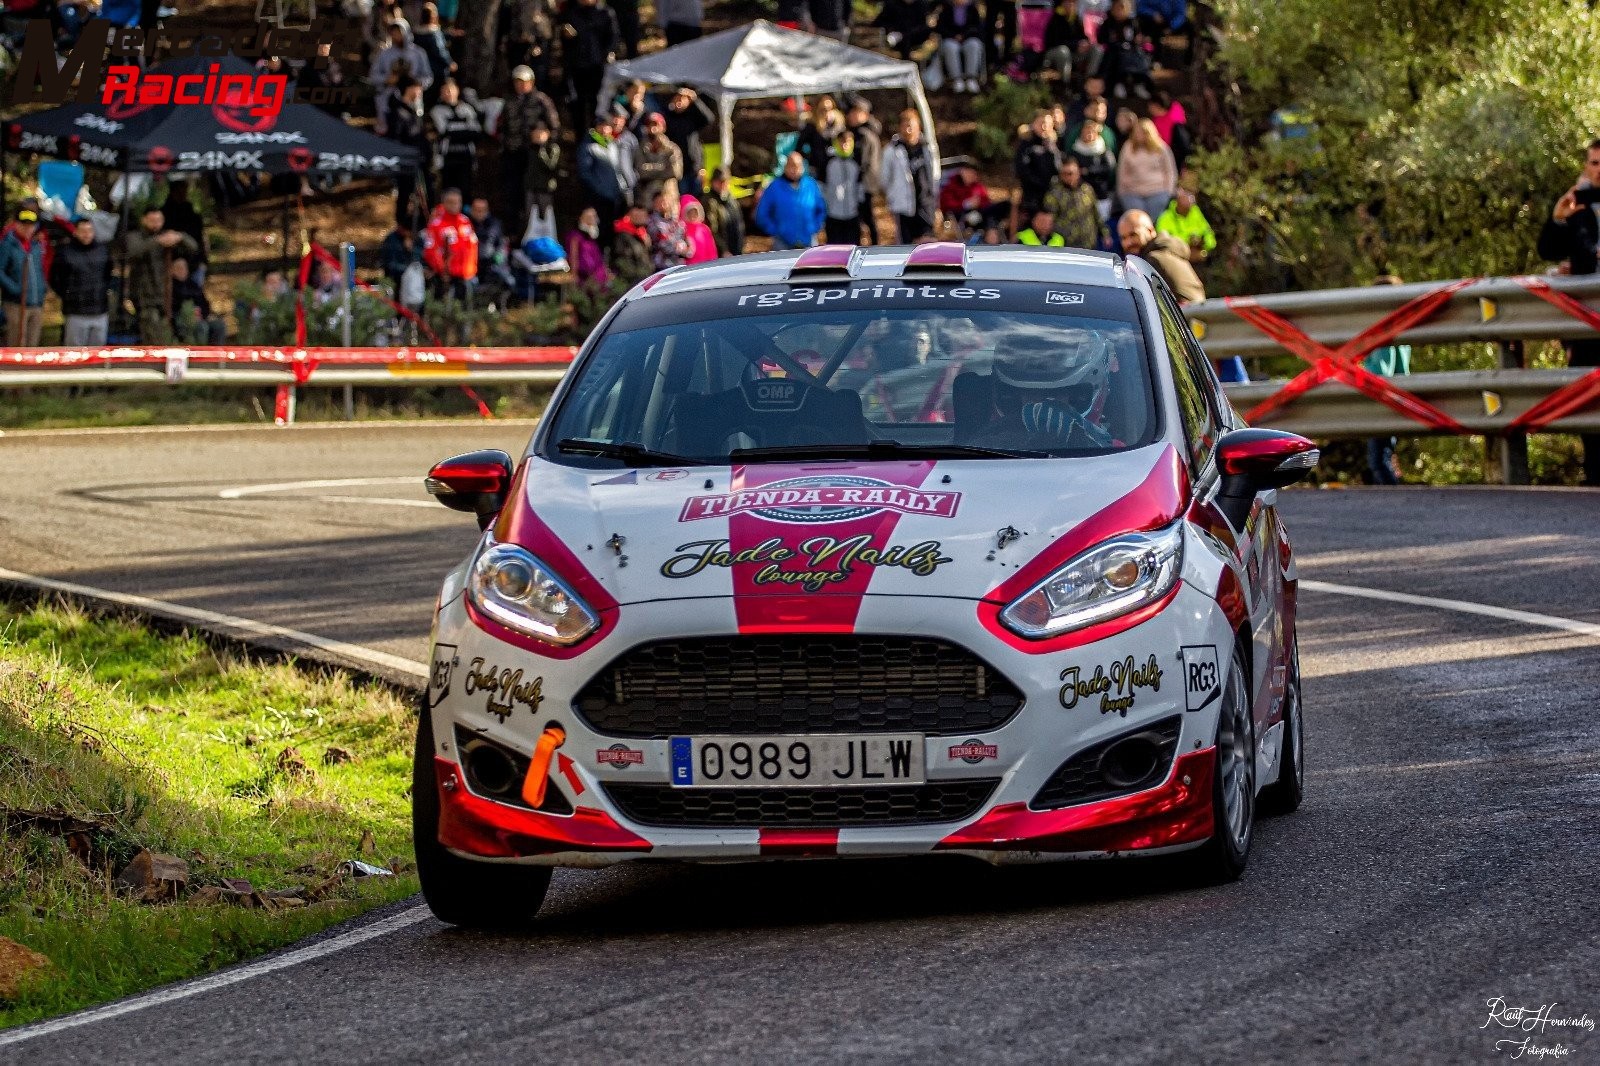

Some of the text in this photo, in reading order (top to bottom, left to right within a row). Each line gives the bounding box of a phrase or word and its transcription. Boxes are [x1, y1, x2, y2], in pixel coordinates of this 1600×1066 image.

[176, 150, 266, 170] 24MX
[316, 152, 401, 171] 24MX
[738, 284, 1001, 307] rg3print.es
[757, 385, 795, 399] OMP
[660, 534, 954, 579] Jade Nails
[753, 564, 849, 593] lounge
[1059, 653, 1164, 710] Jade Nails
[1189, 661, 1216, 692] RG3
[677, 740, 912, 780] E 0989 JLW
